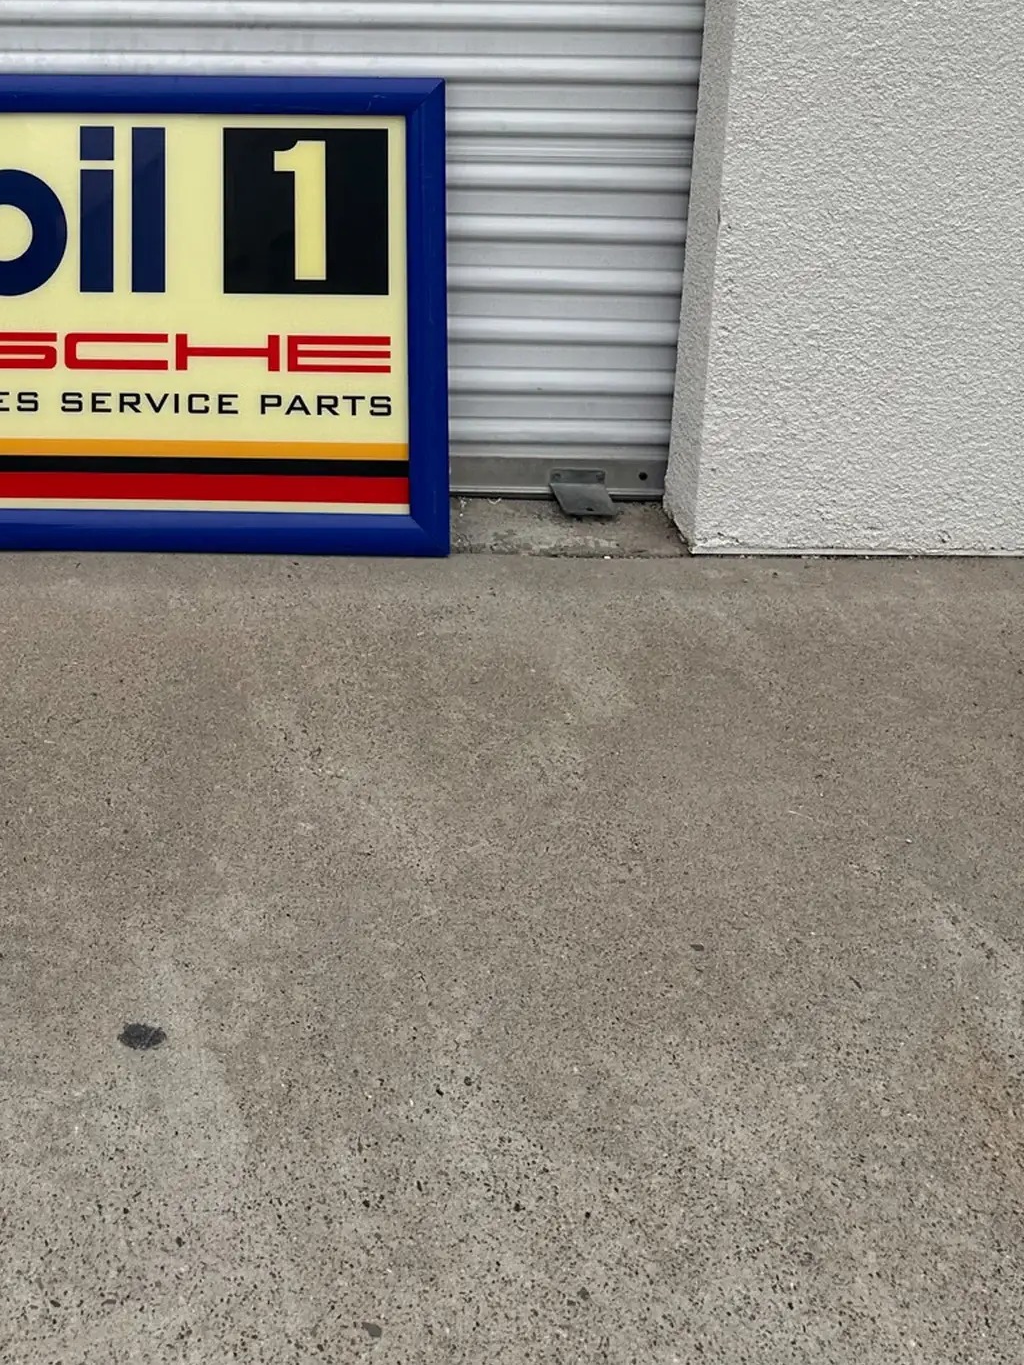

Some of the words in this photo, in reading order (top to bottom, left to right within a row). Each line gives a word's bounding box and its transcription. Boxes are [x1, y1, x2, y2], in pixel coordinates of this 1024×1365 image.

[273, 140, 327, 281] 1
[60, 391, 240, 415] SERVICE
[260, 394, 393, 418] PARTS
